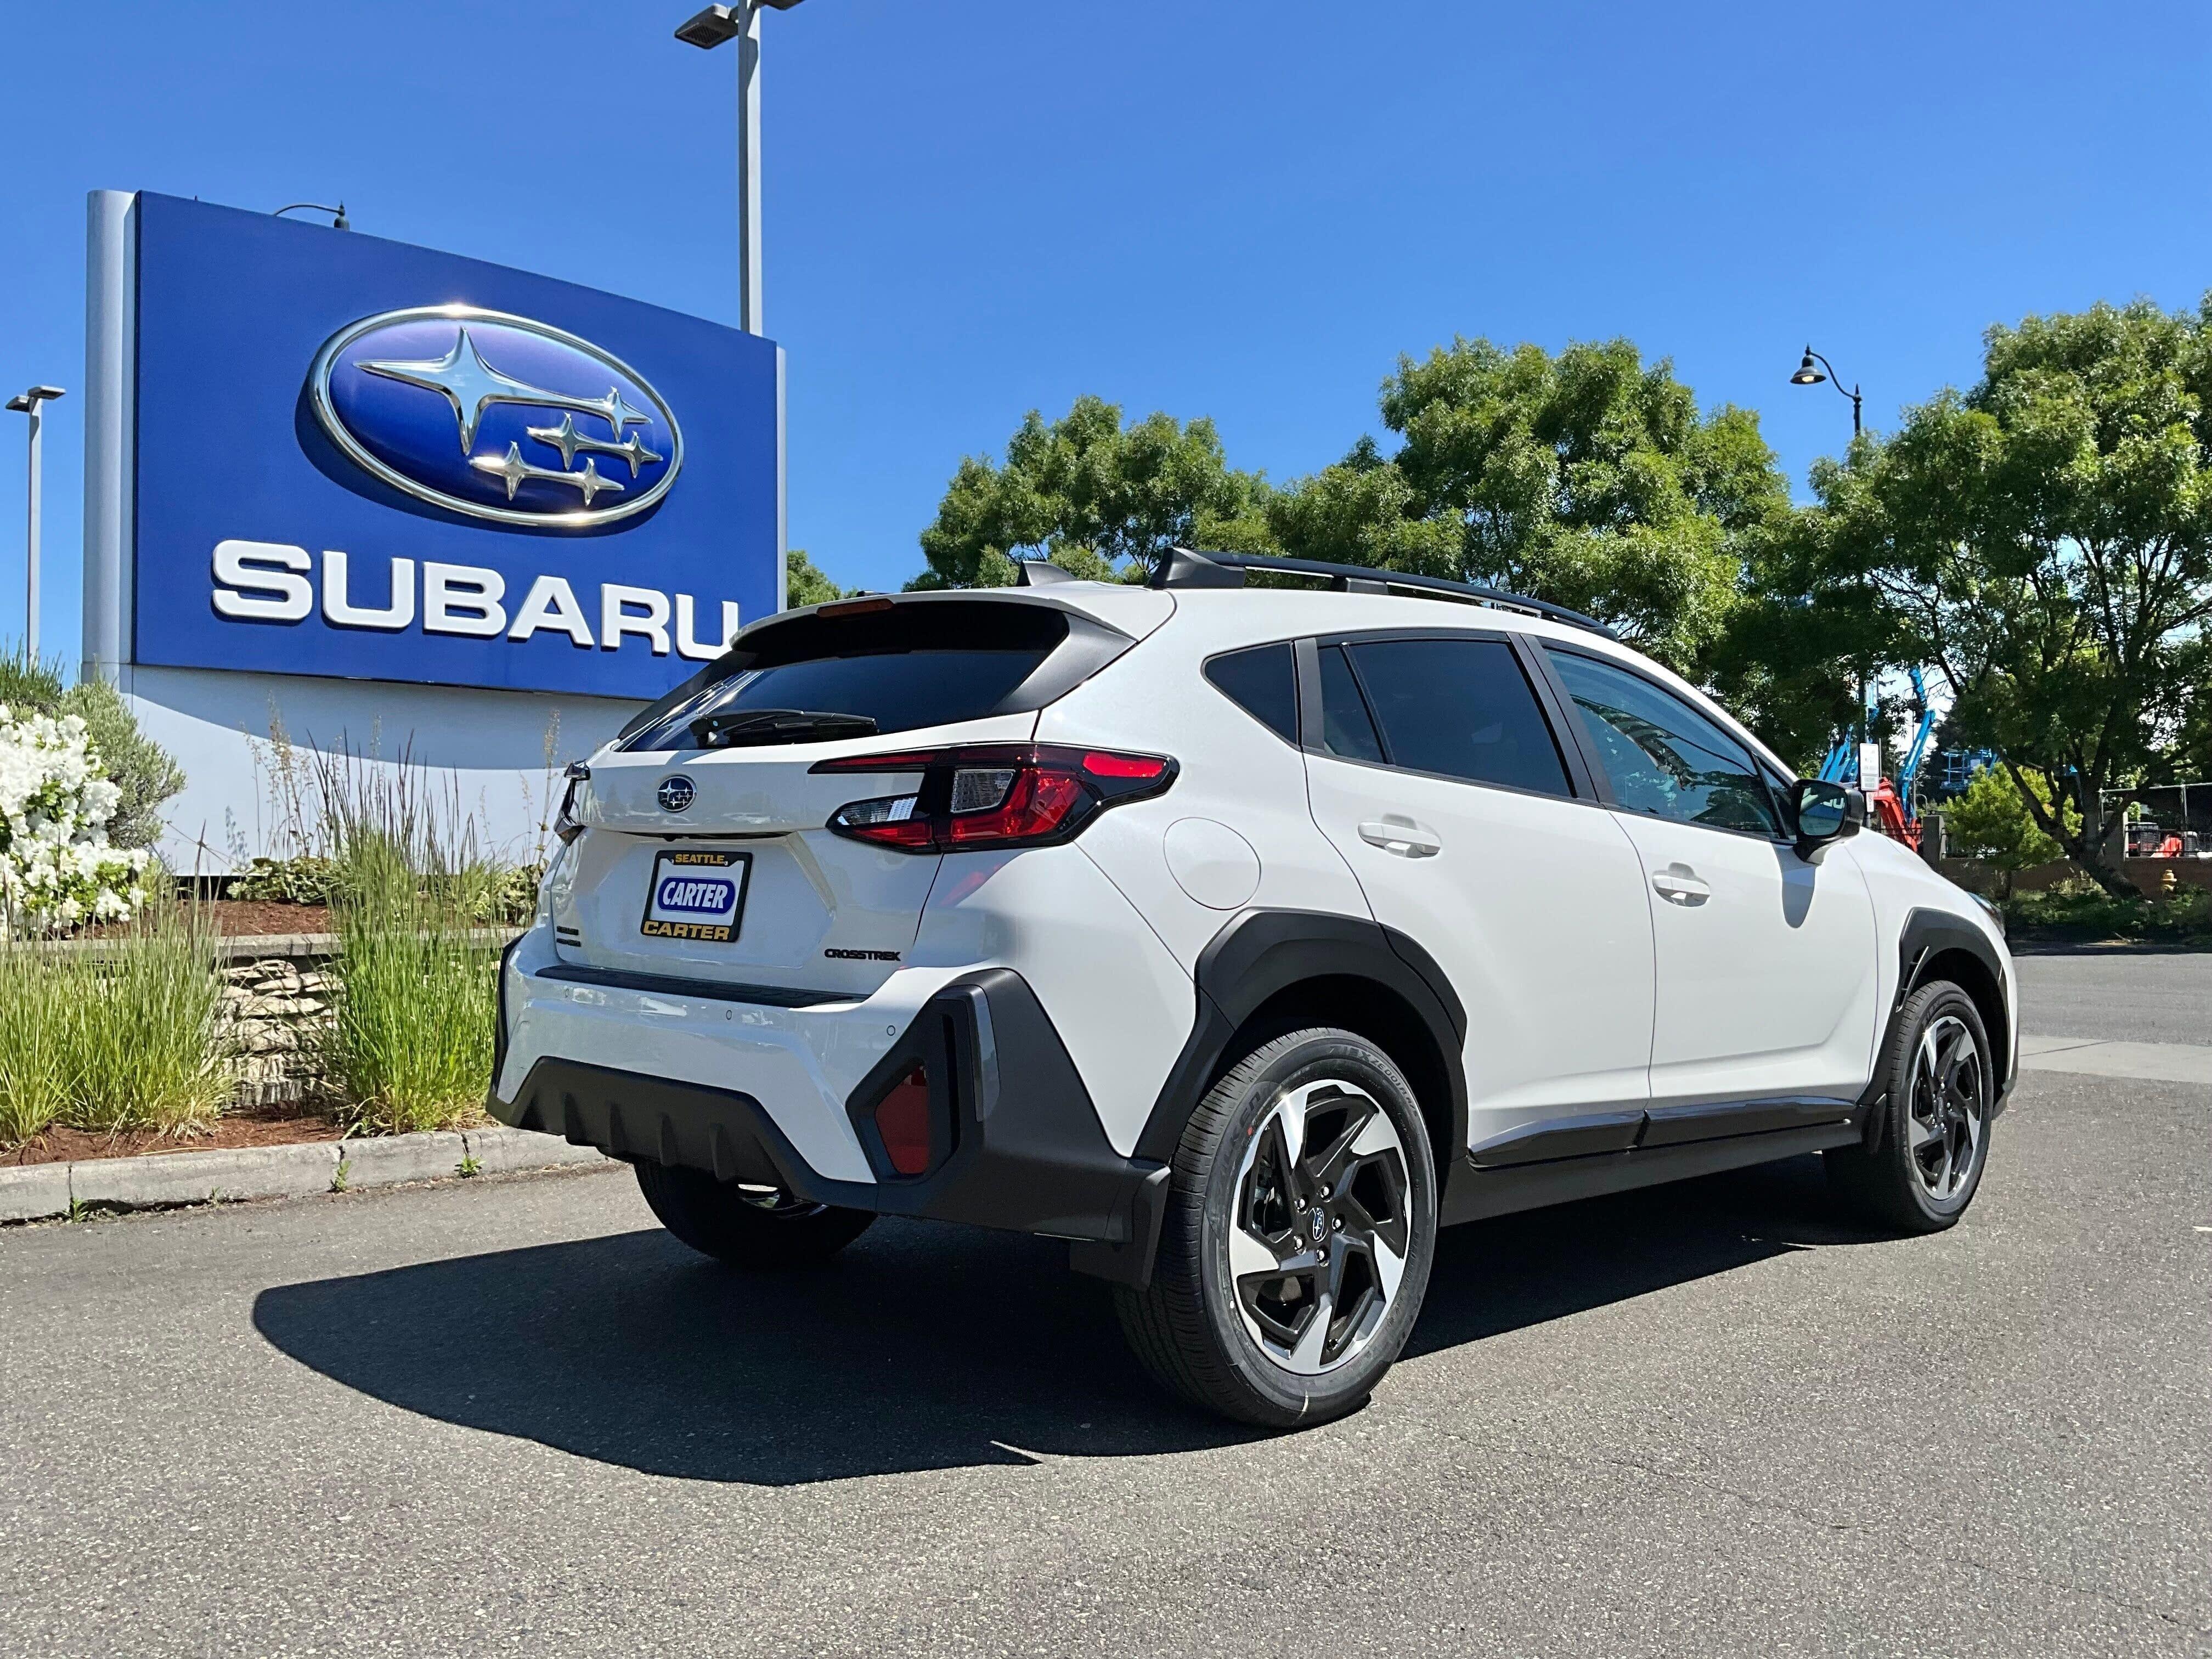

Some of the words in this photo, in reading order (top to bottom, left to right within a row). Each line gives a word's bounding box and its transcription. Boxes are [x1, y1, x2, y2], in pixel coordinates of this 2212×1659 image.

[212, 539, 738, 659] SUBARU
[675, 854, 725, 864] SEATTLE
[662, 881, 728, 909] CARTER
[643, 921, 730, 940] CARTER
[824, 949, 901, 961] CROSSTREK
